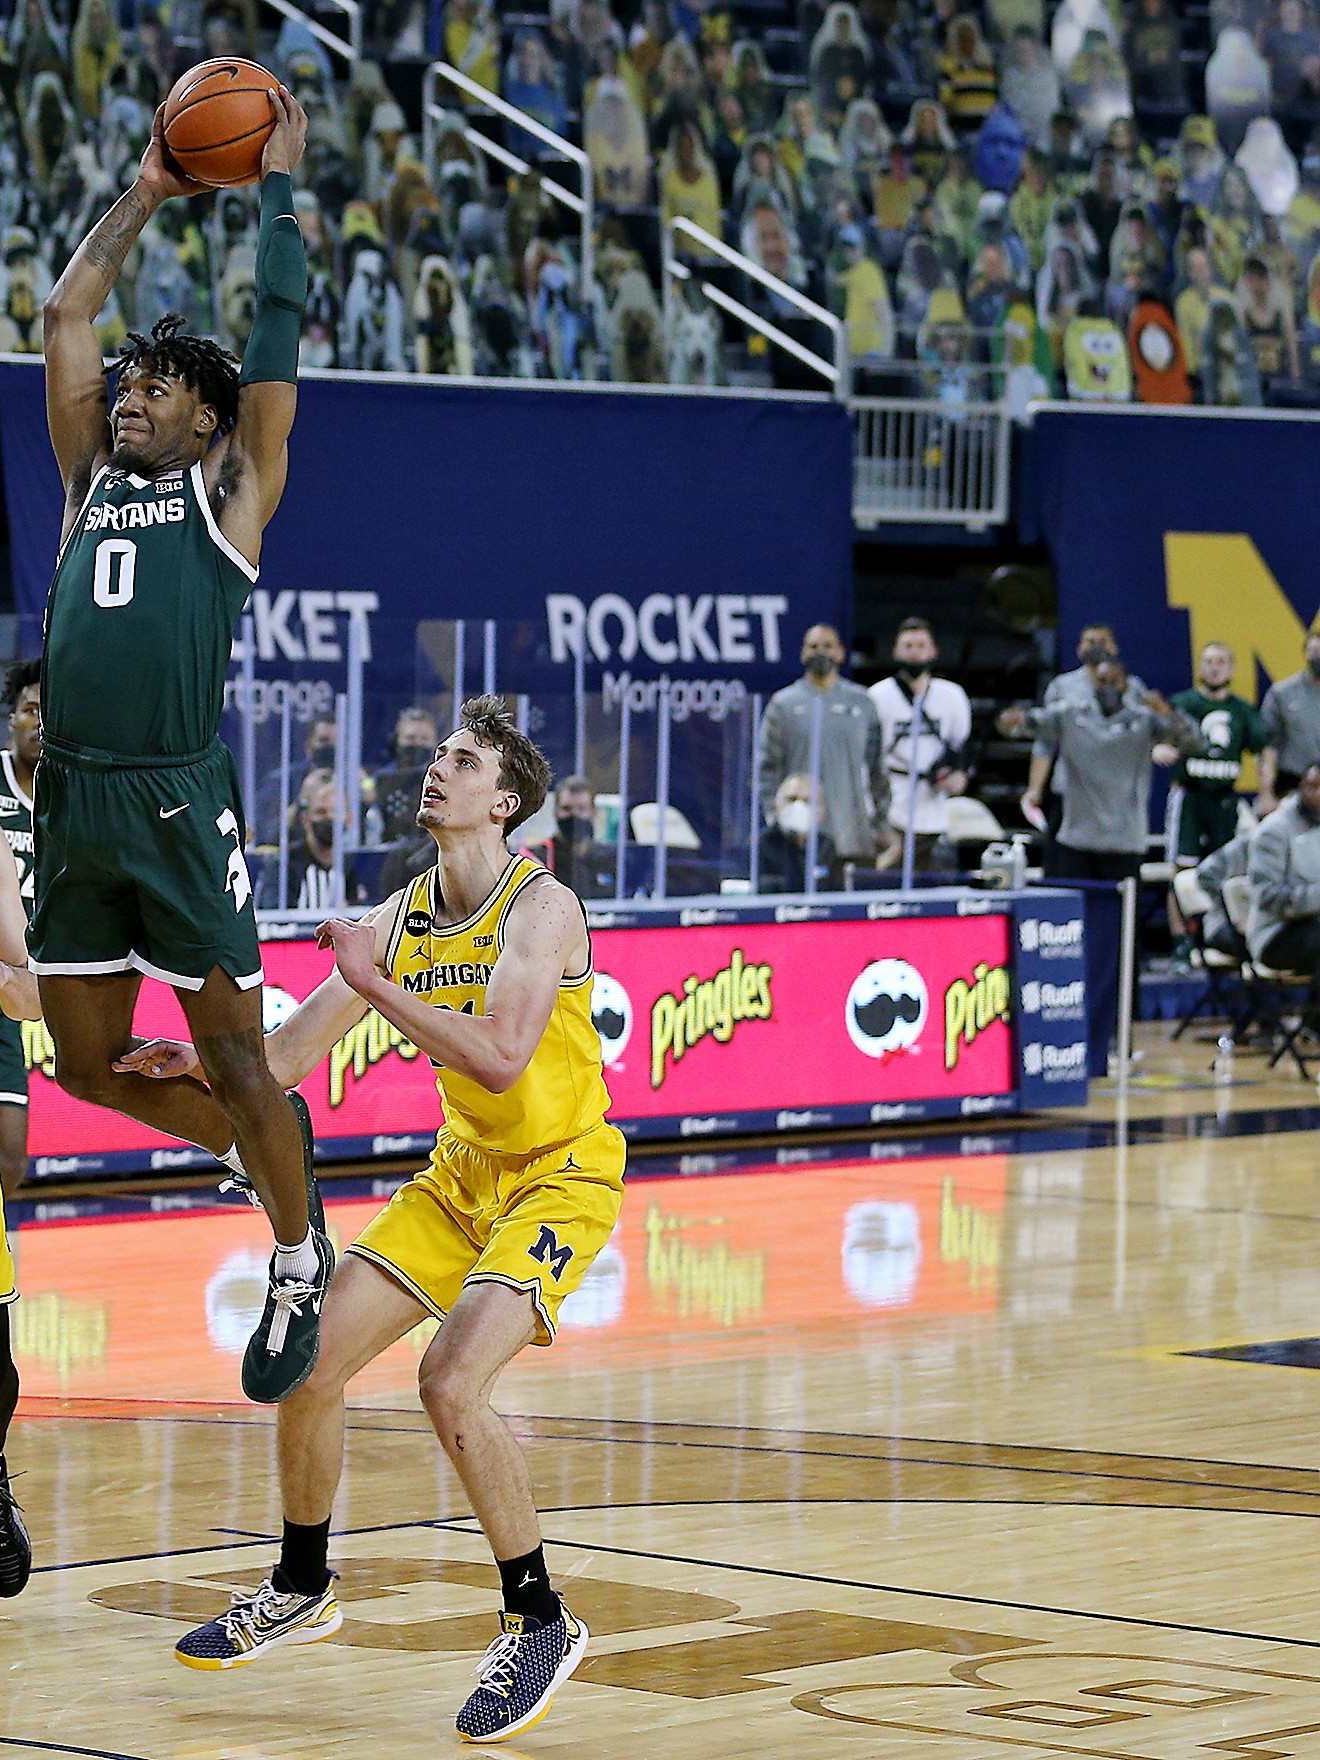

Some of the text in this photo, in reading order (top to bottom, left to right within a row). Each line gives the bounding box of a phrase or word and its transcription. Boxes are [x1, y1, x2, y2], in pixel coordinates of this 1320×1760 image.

[93, 538, 138, 609] 0
[231, 589, 380, 662] KET
[545, 592, 788, 664] ROCKET
[601, 670, 748, 723] Mortgage
[408, 918, 429, 929] BLM
[651, 948, 773, 1090] Pringles
[945, 962, 1011, 1072] Prin
[526, 1223, 575, 1284] M
